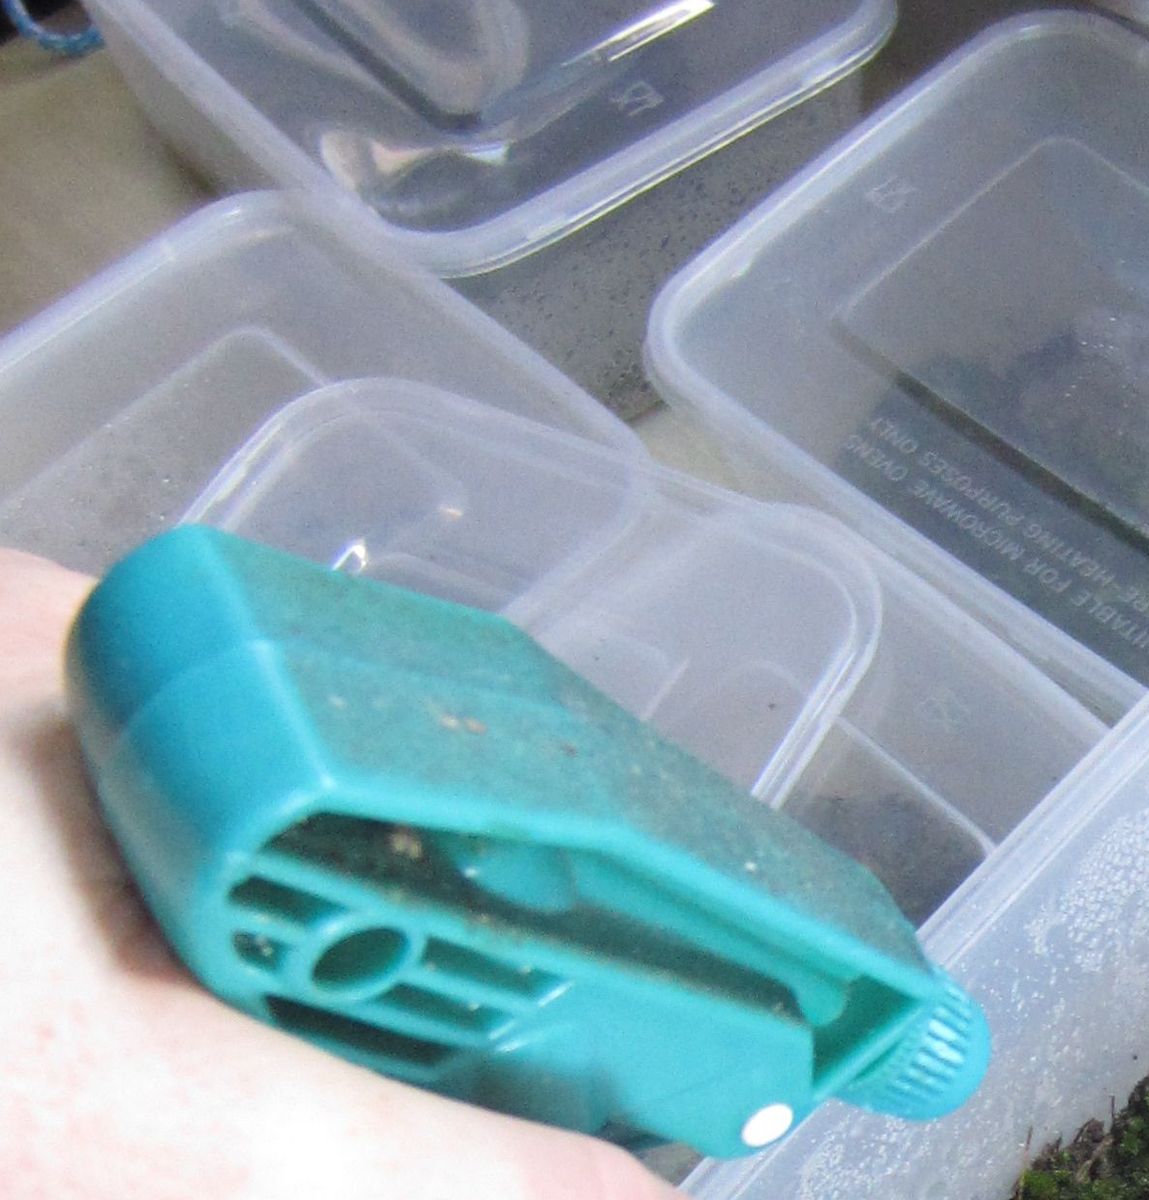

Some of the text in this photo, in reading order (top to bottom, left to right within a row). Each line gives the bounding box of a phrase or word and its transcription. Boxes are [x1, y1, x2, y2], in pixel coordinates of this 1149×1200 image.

[842, 433, 908, 482] OVENS
[869, 417, 919, 454] ONLY
[918, 452, 1024, 521] PURPOSES
[911, 480, 1024, 560] MICROWAVE
